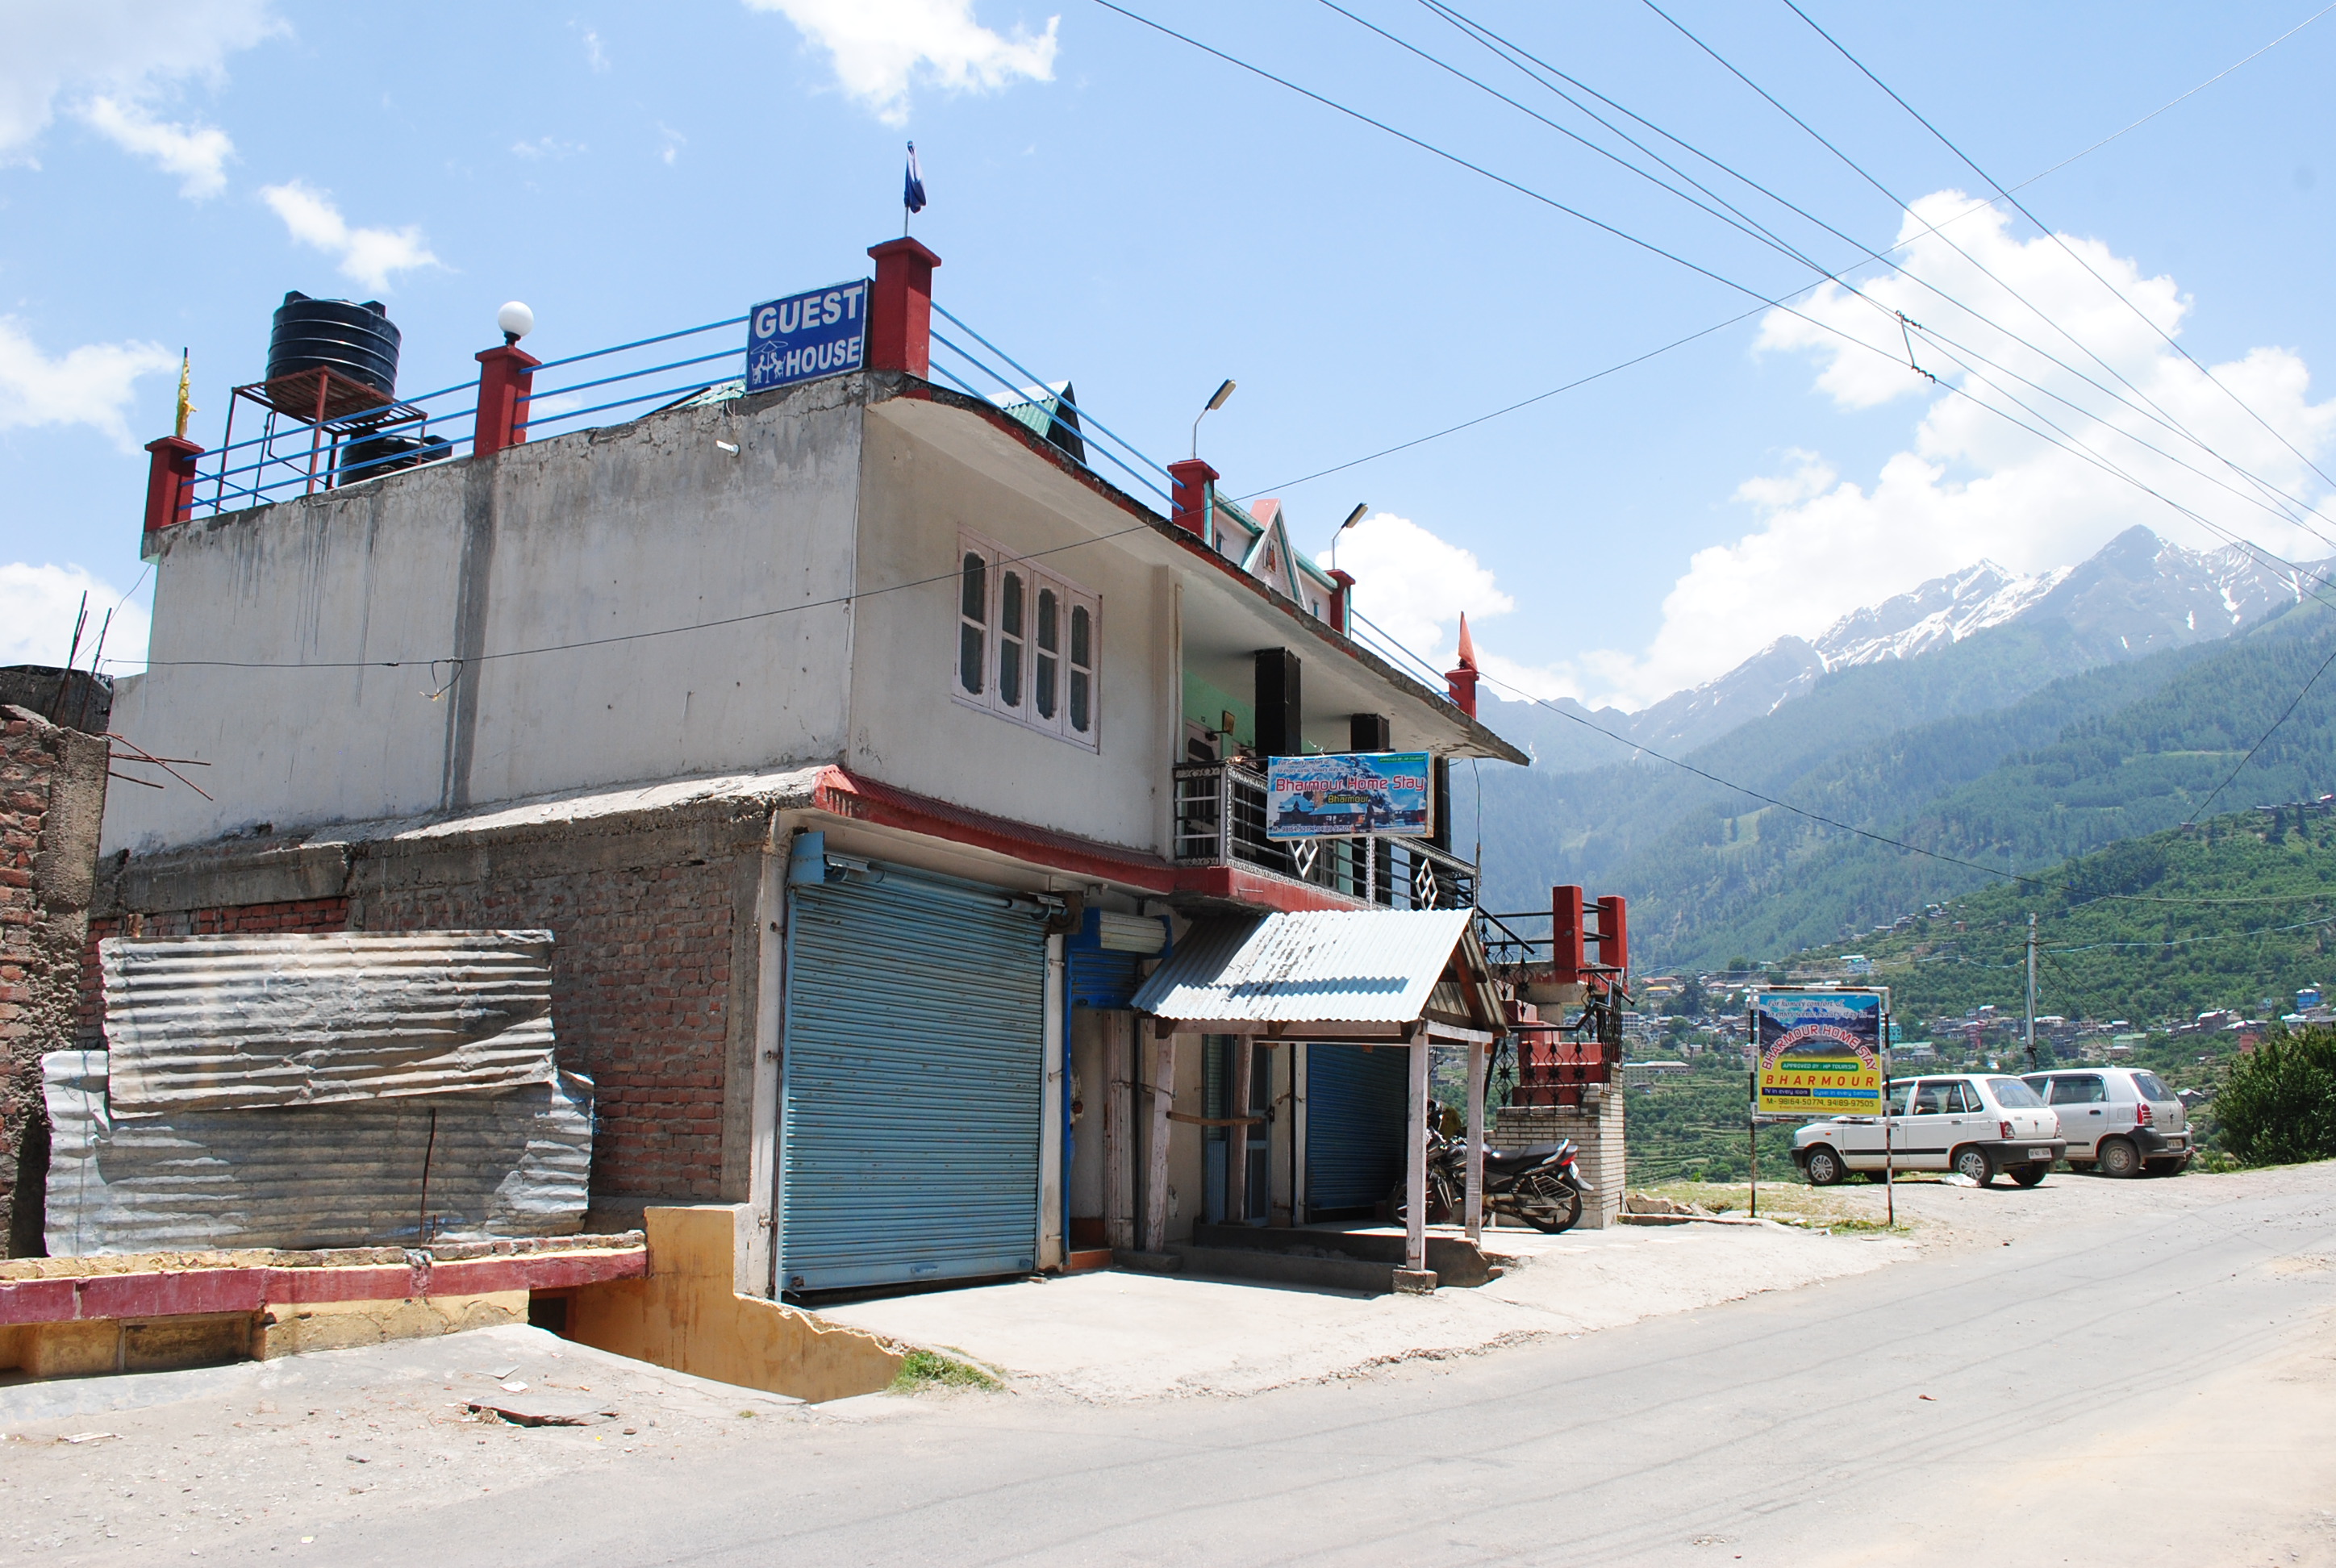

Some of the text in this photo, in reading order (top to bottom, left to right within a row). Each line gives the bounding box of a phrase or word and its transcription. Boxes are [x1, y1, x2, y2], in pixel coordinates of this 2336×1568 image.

[755, 286, 863, 339] GUEST
[786, 336, 861, 377] HOUSE
[1275, 775, 1425, 792] Bharmour Home Stay
[1328, 794, 1369, 803] Bharmour
[1781, 1000, 1805, 1008] homely
[1775, 1011, 1794, 1020] enjoy
[1817, 1011, 1841, 1019] beauty
[1842, 1011, 1858, 1020] stay
[1762, 1024, 1878, 1071] BHARMOUR HOME STAY
[1766, 1074, 1874, 1086] BHARMOUR
